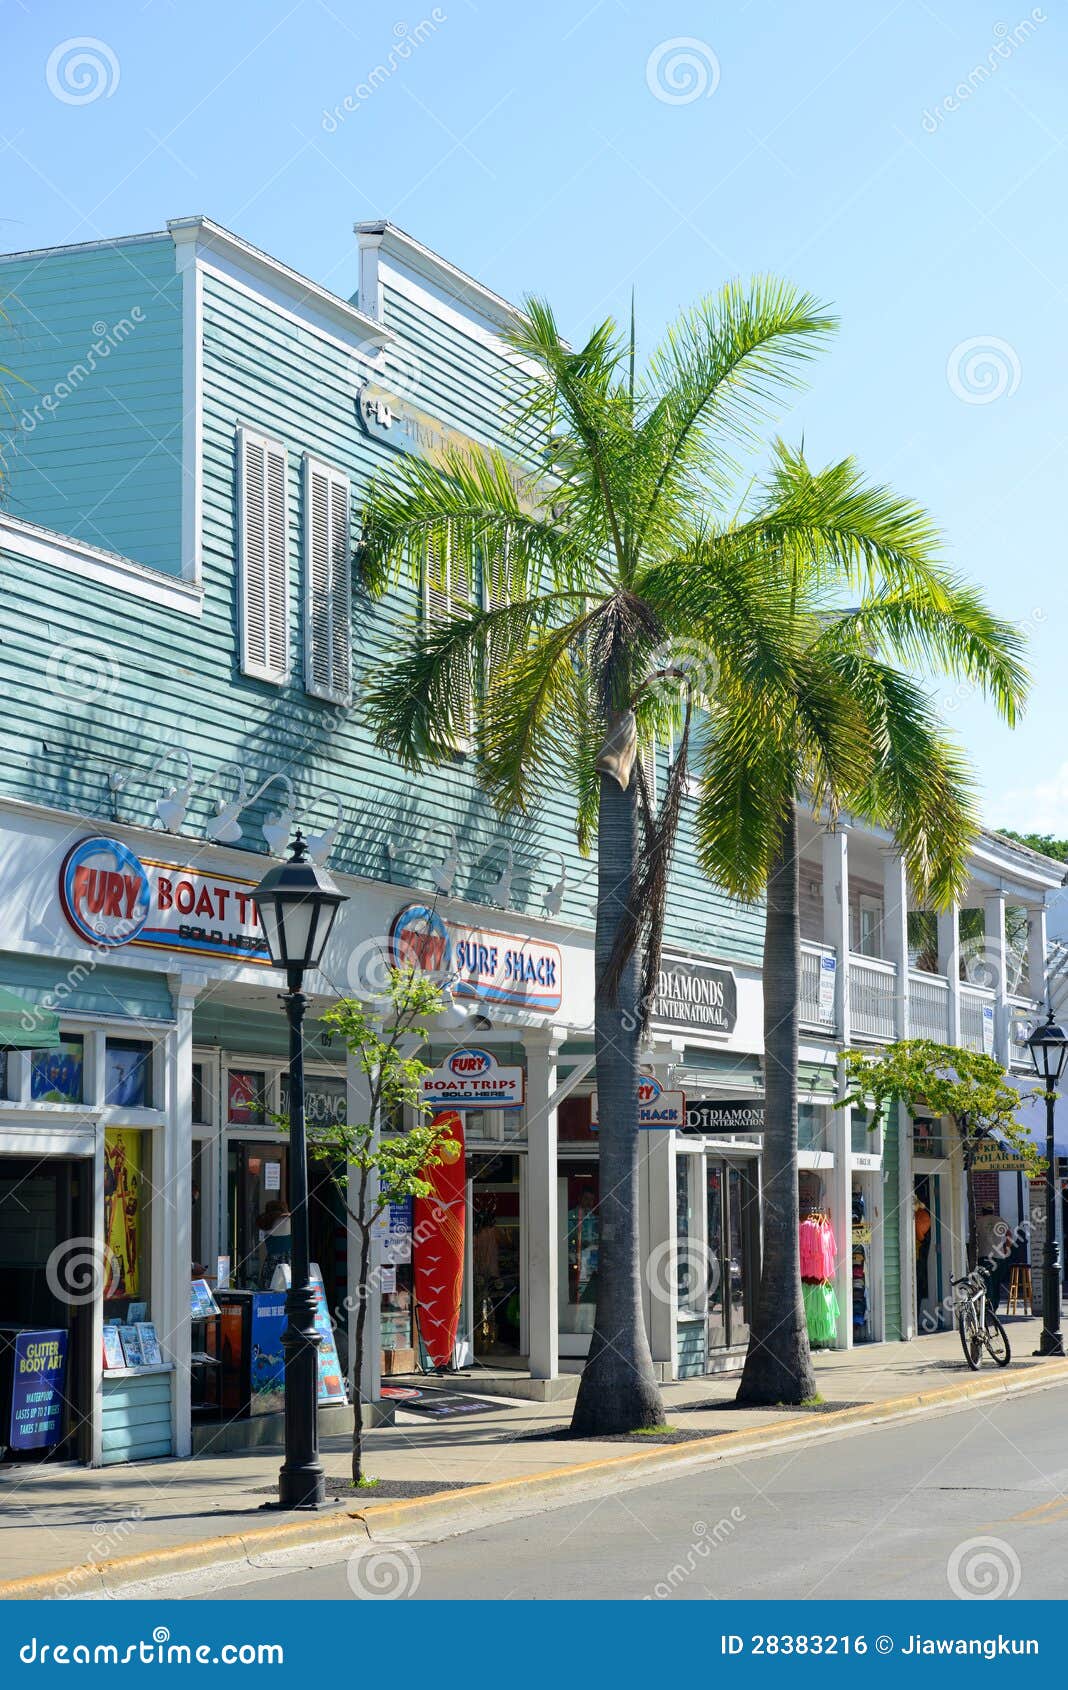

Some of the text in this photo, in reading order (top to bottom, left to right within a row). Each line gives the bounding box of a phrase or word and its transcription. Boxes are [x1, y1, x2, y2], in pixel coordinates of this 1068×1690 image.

[73, 865, 142, 919] FURY
[158, 877, 230, 921] BOAT
[179, 925, 222, 944] SOLD
[455, 940, 557, 986] SURF SHACK
[659, 971, 724, 1007] DIAMONDS
[659, 999, 724, 1026] INTERNATIONAL
[451, 1058, 486, 1072] FURY
[424, 1080, 517, 1090] BOAT TRIPS
[639, 1085, 654, 1100] RY
[638, 1108, 679, 1121] HACK
[974, 1152, 1009, 1165] POLAR
[26, 1342, 59, 1358] GLITTER
[20, 1355, 63, 1373] BODY ART
